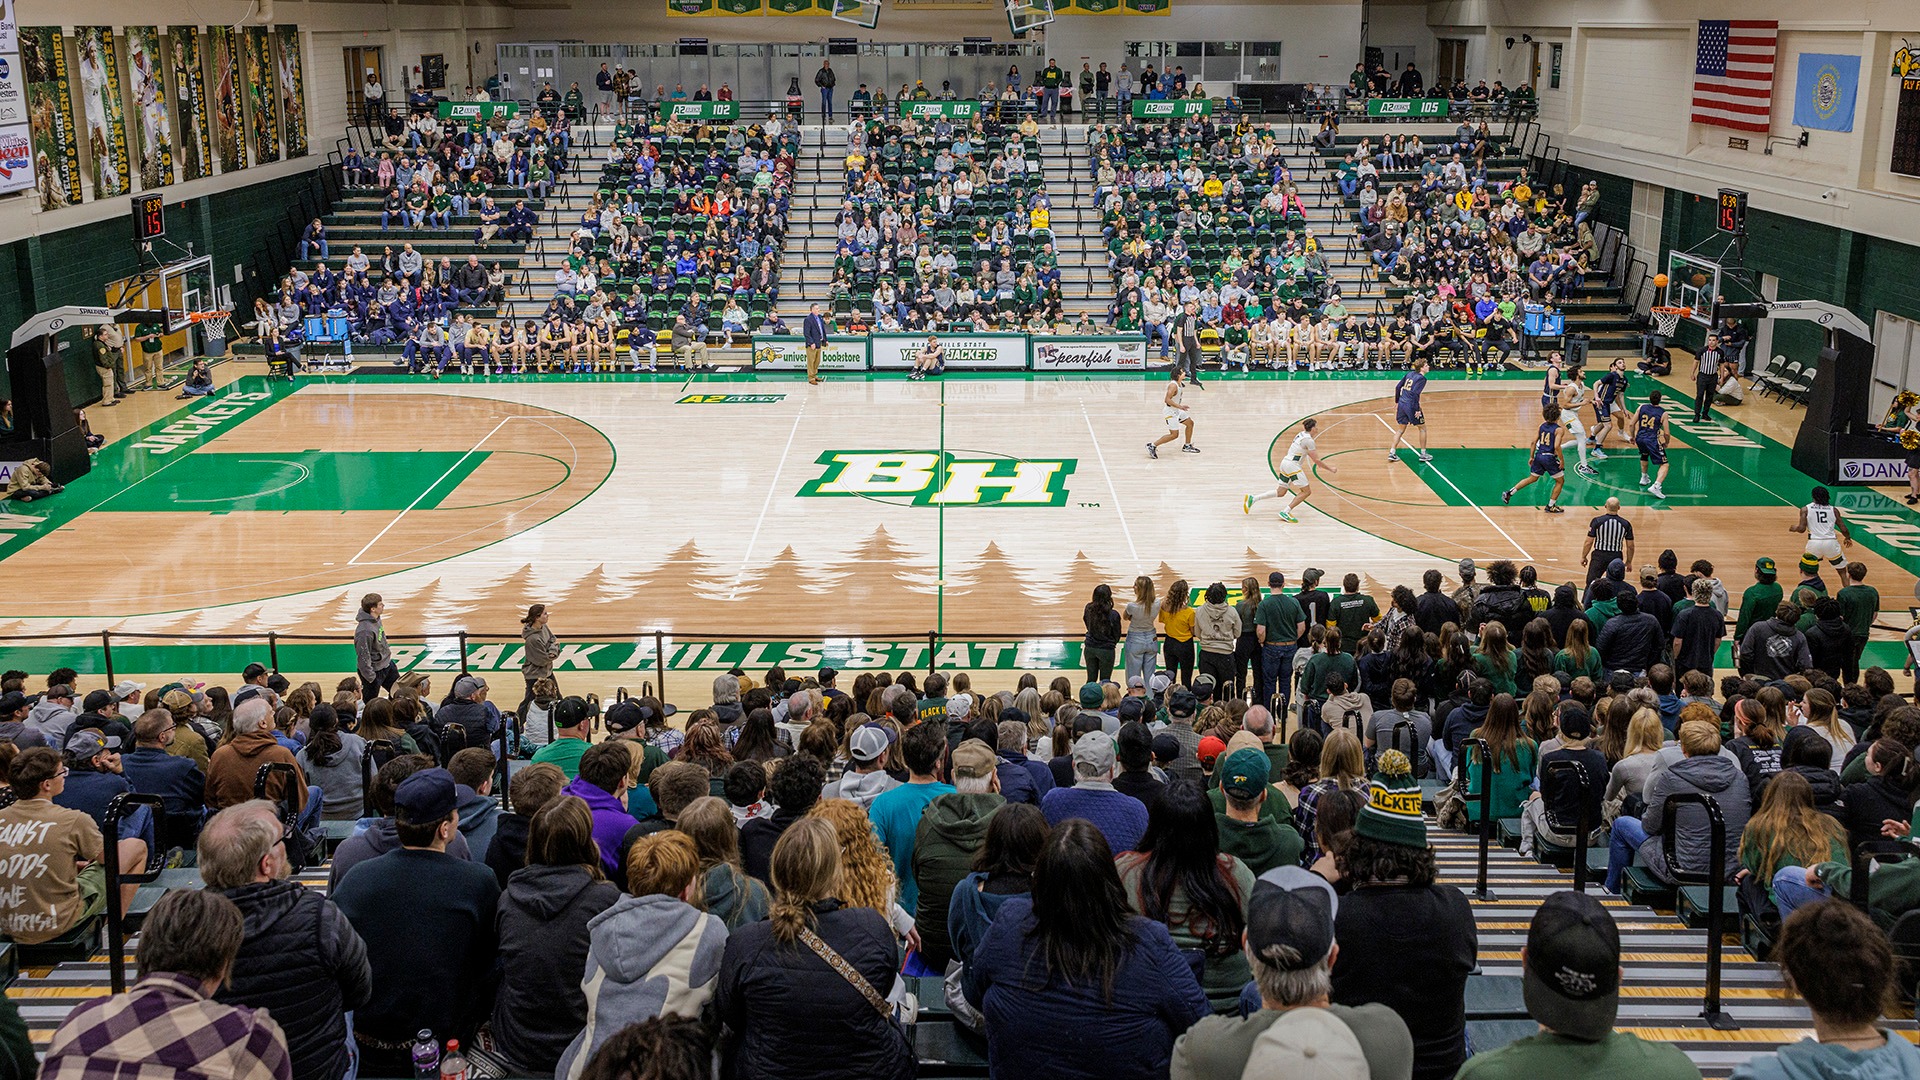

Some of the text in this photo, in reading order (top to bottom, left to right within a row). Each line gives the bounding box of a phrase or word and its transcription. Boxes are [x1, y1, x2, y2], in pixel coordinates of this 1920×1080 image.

[52, 33, 66, 77] RODEO
[0, 90, 18, 98] estern
[189, 72, 200, 121] JACKET
[233, 74, 241, 113] TRACK
[261, 36, 279, 155] TRIATHLON
[58, 80, 74, 145] WOMEN'S
[197, 84, 207, 131] TRACK
[713, 104, 730, 115] 102
[953, 104, 971, 115] 103
[1185, 102, 1203, 113] 104
[1421, 102, 1439, 113] 105
[55, 112, 72, 196] YELLOW JACKET
[201, 134, 211, 176] MEN'S
[67, 160, 82, 201] MEN'S
[146, 199, 162, 213] 8:39
[1722, 194, 1737, 208] 8:39
[147, 212, 161, 234] 15
[1722, 209, 1734, 230] 15
[79, 308, 109, 316] SPALDING
[822, 351, 861, 362] bookstore
[945, 348, 998, 361] JACKETS
[1045, 348, 1113, 368] Spearfish
[681, 395, 726, 403] A2
[130, 391, 271, 454] JACKETS
[1641, 414, 1656, 430] 24
[1540, 431, 1551, 446] 14
[1815, 511, 1828, 524] 12
[1309, 602, 1317, 626] 1
[618, 643, 826, 670] HILLS
[844, 643, 1052, 670] STATE
[921, 706, 941, 720] BLACK
